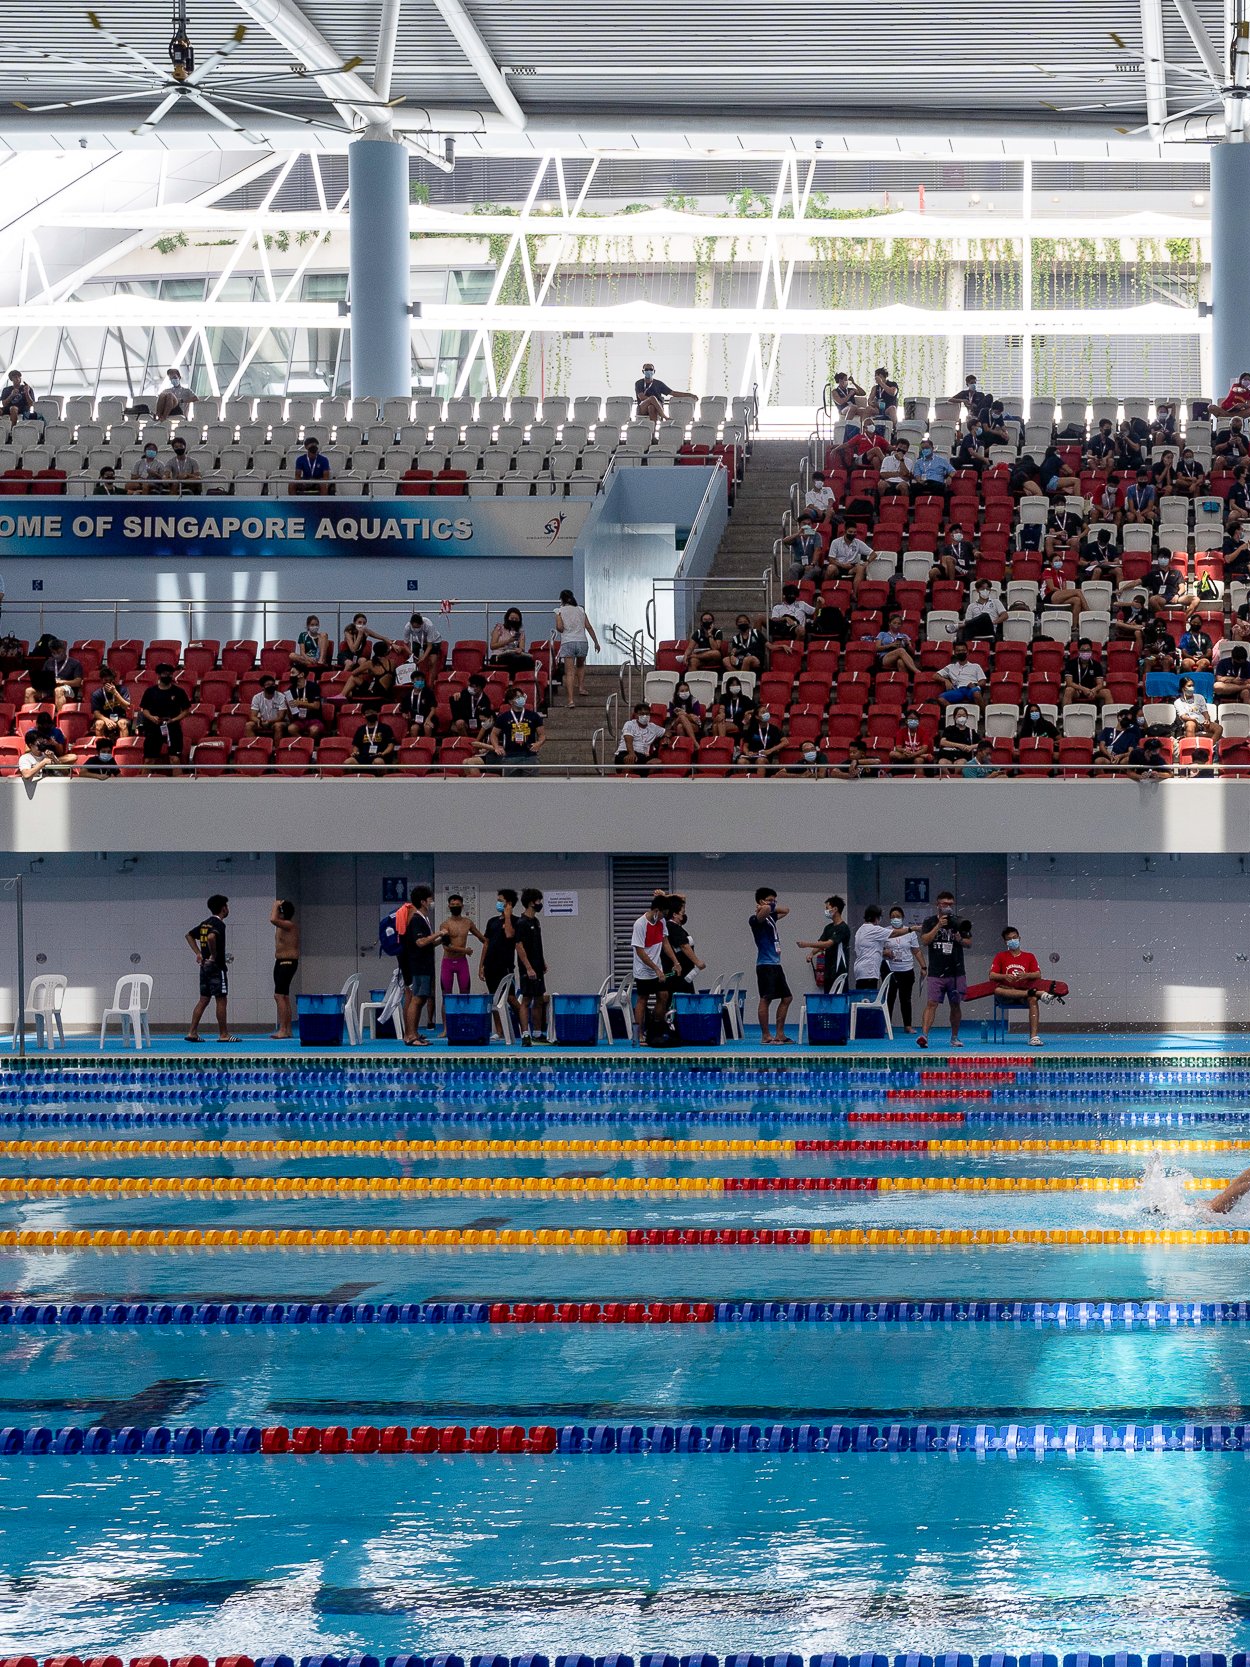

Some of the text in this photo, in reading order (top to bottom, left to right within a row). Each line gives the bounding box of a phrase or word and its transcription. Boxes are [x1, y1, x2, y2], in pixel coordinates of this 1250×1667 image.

[72, 516, 113, 538] OF
[123, 516, 305, 539] SINGAPORE
[315, 517, 473, 541] AQUATICS
